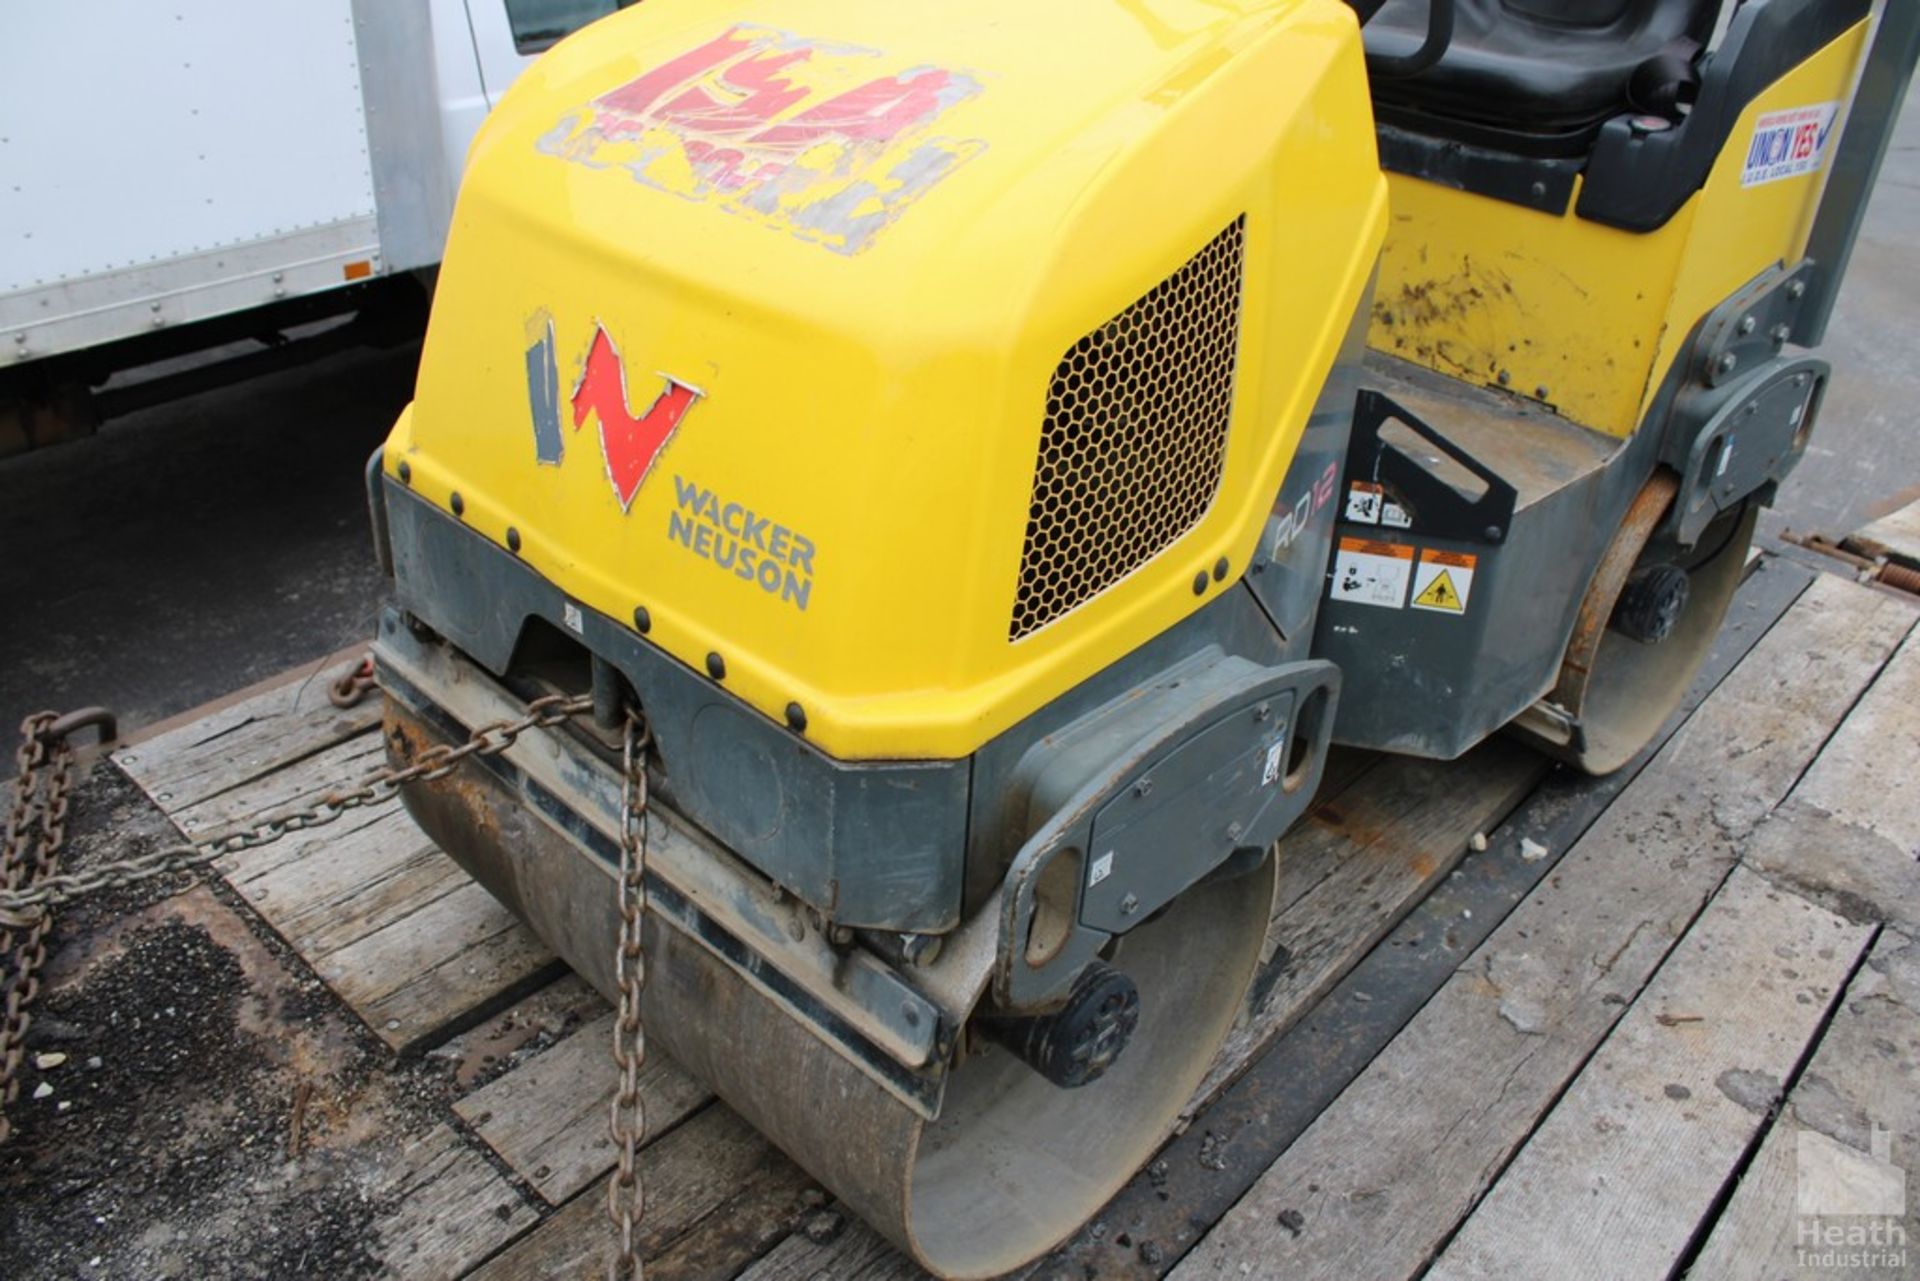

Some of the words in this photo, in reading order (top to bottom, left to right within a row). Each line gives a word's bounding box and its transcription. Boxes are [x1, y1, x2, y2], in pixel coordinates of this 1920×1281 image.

[1747, 128, 1794, 169] UNION
[1791, 123, 1818, 159] YES
[668, 510, 812, 611] NEUSON
[674, 475, 816, 575] WACKER
[1272, 461, 1338, 562] RD12
